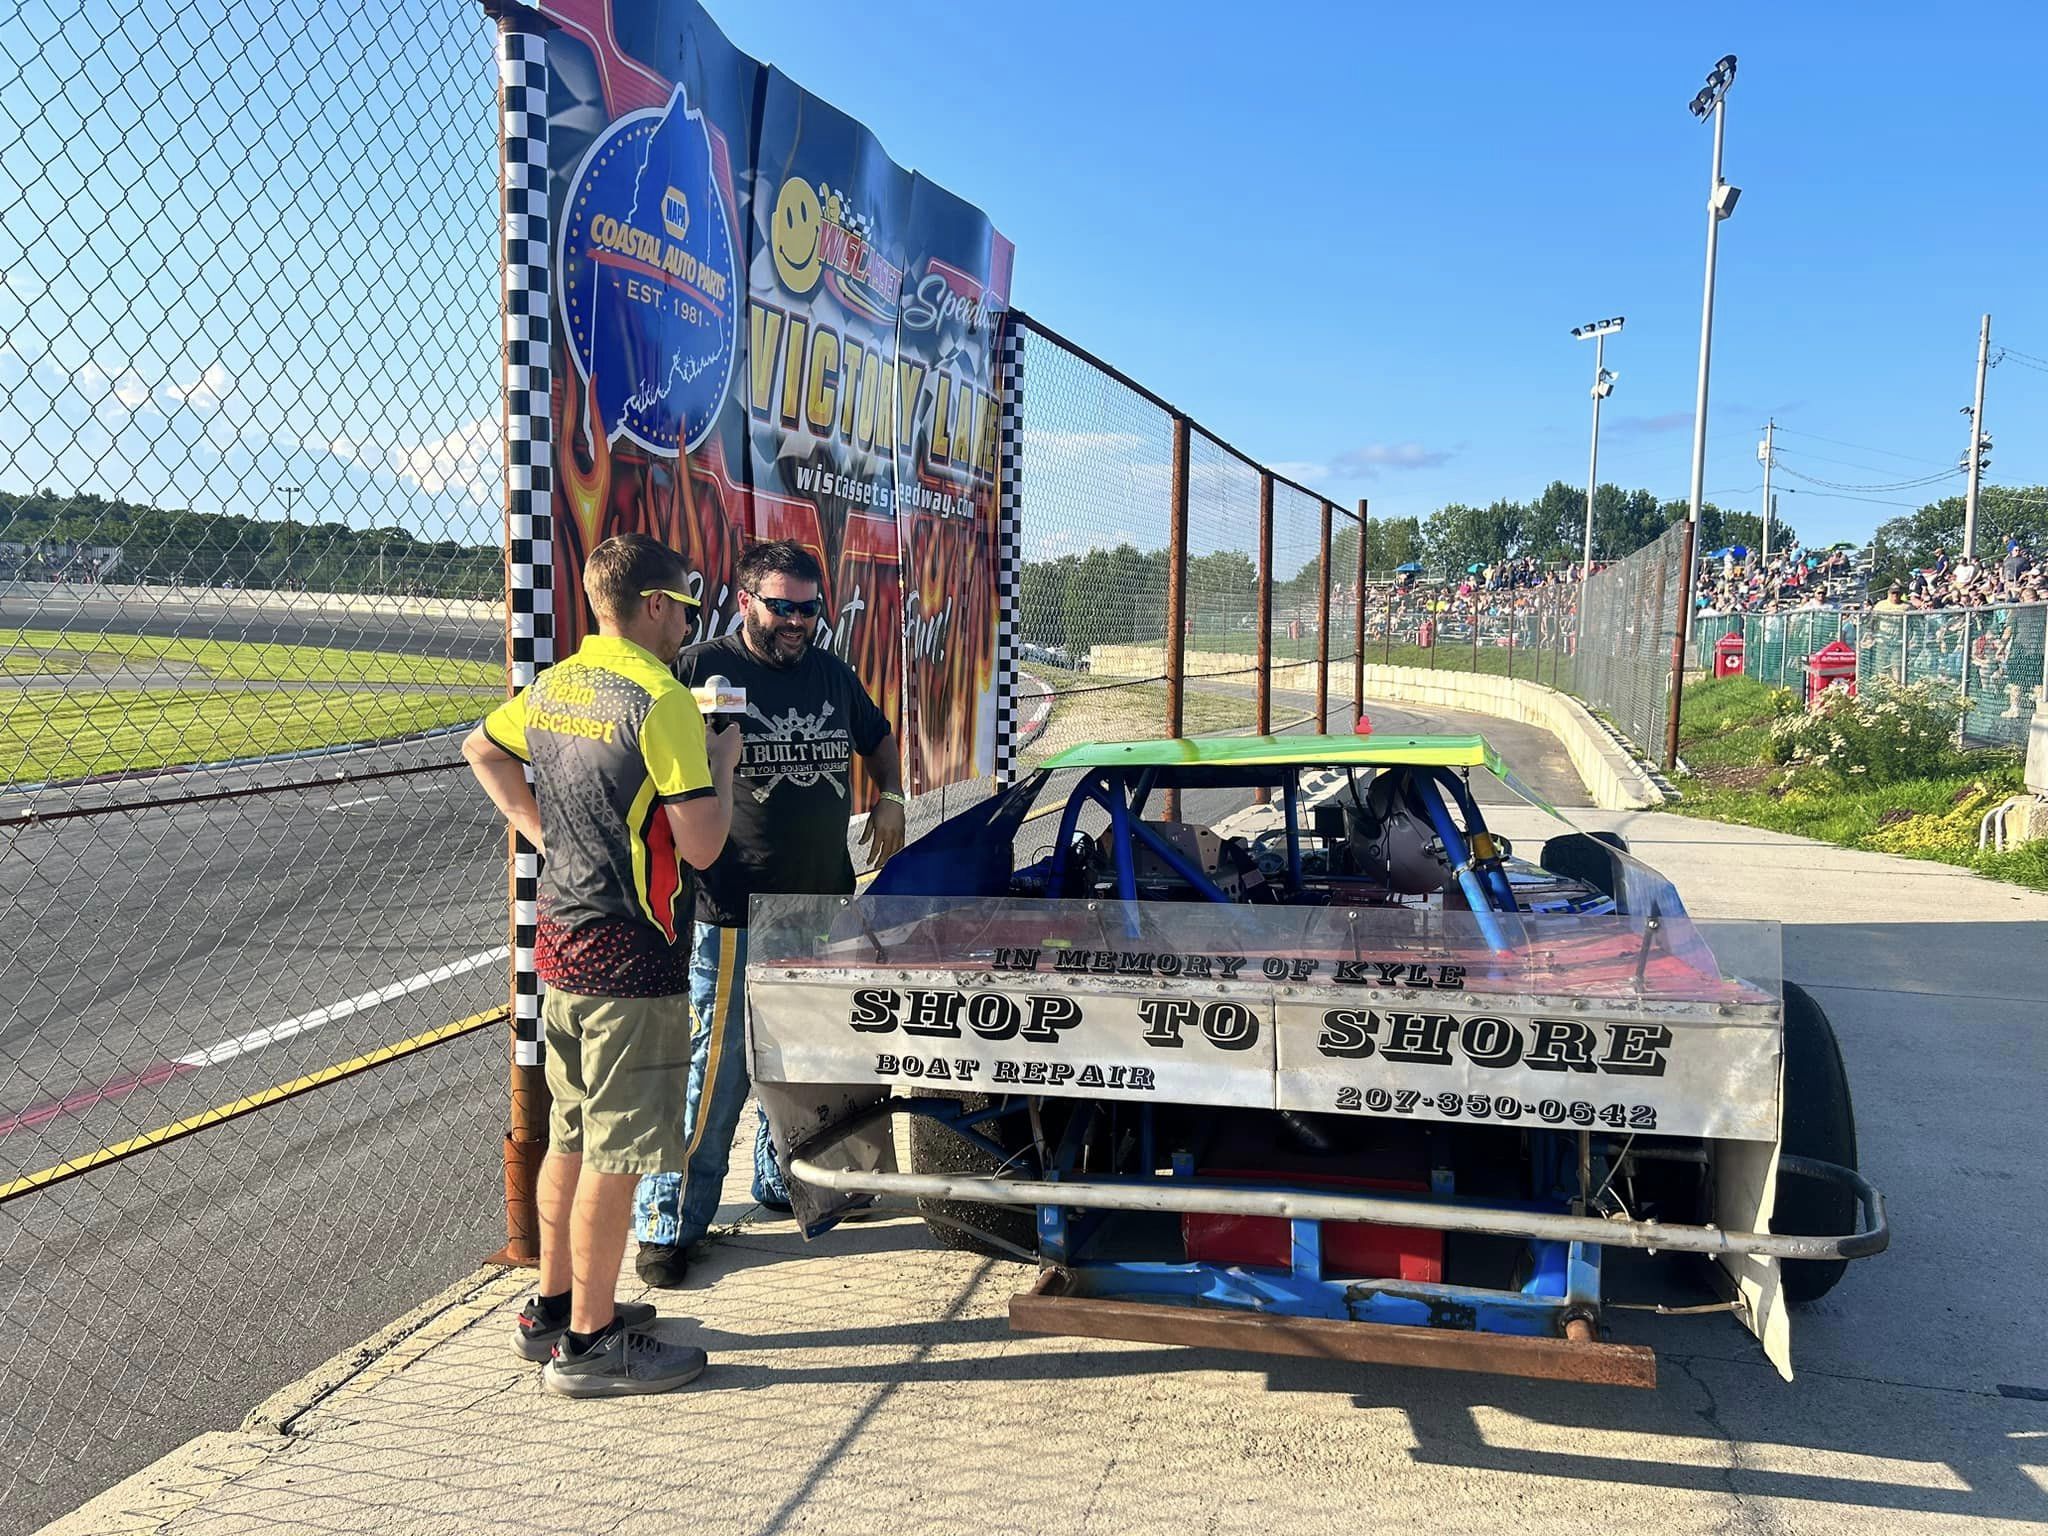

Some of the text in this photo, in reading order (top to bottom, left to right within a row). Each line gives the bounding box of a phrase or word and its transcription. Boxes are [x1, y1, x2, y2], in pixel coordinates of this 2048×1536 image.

[590, 213, 727, 302] COASTAL AUTO PARTS
[626, 279, 703, 328] EST. 1981
[903, 274, 1002, 350] Speedway
[750, 301, 1000, 484] VICTORY LANE
[796, 464, 976, 519] wiscassetspeedway.com
[752, 744, 809, 764] BUILT
[811, 741, 849, 760] MINE
[757, 765, 777, 774] YOU
[780, 763, 814, 773] BOUGHT
[991, 947, 1467, 990] IN MEMORY OF KYLE
[848, 987, 1674, 1077] SHOP TO SHORE
[873, 1053, 1157, 1091] BOAT REPAIR
[1335, 1086, 1658, 1130] 207-350-0642
